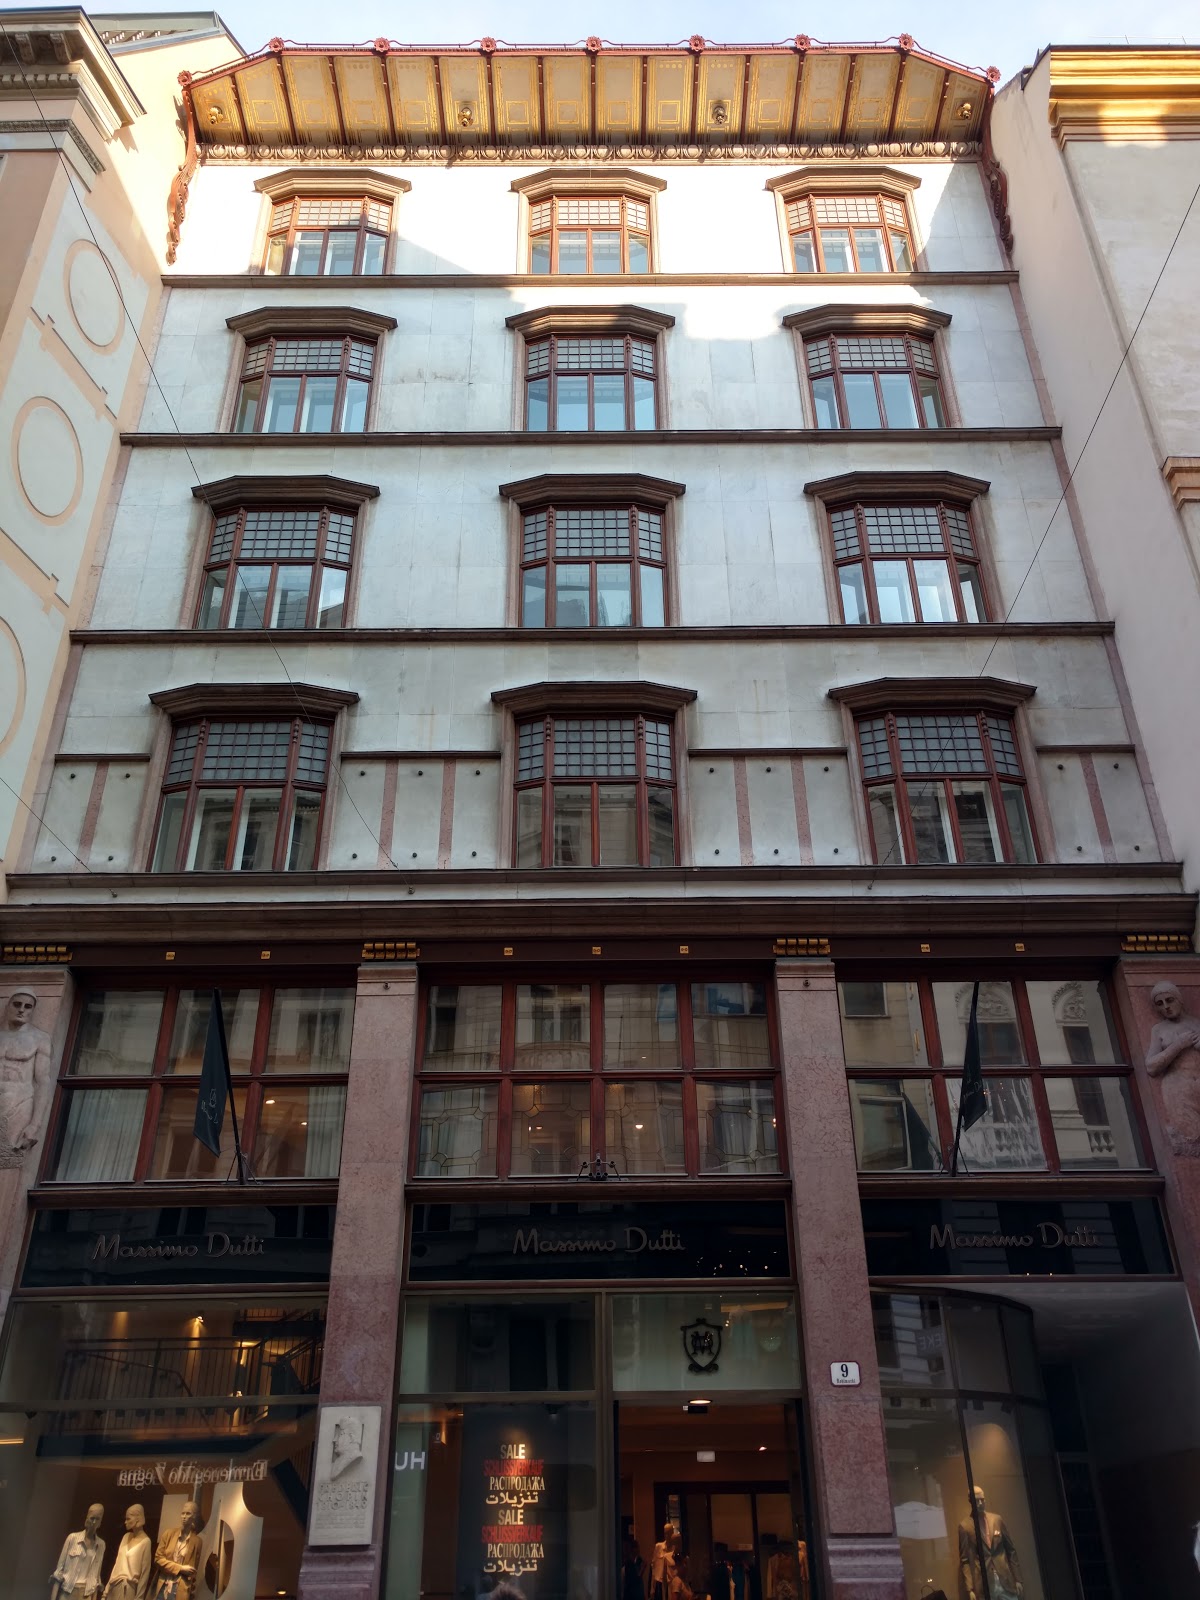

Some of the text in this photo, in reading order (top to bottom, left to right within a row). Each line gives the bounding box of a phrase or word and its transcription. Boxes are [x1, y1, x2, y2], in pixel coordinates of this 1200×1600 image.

[513, 1227, 686, 1254] Massimo Dutti
[930, 1222, 1101, 1249] Massimo Dutti
[92, 1232, 265, 1260] Massimo Dutti
[840, 1363, 849, 1378] 9
[500, 1444, 525, 1459] SALE
[489, 1476, 545, 1491] РАСПРОДАЖА
[485, 1491, 539, 1507] تنزيلات
[498, 1509, 524, 1525] SALE
[487, 1543, 545, 1559] РАСПРОДАЖА
[483, 1559, 538, 1576] تنزيلات
